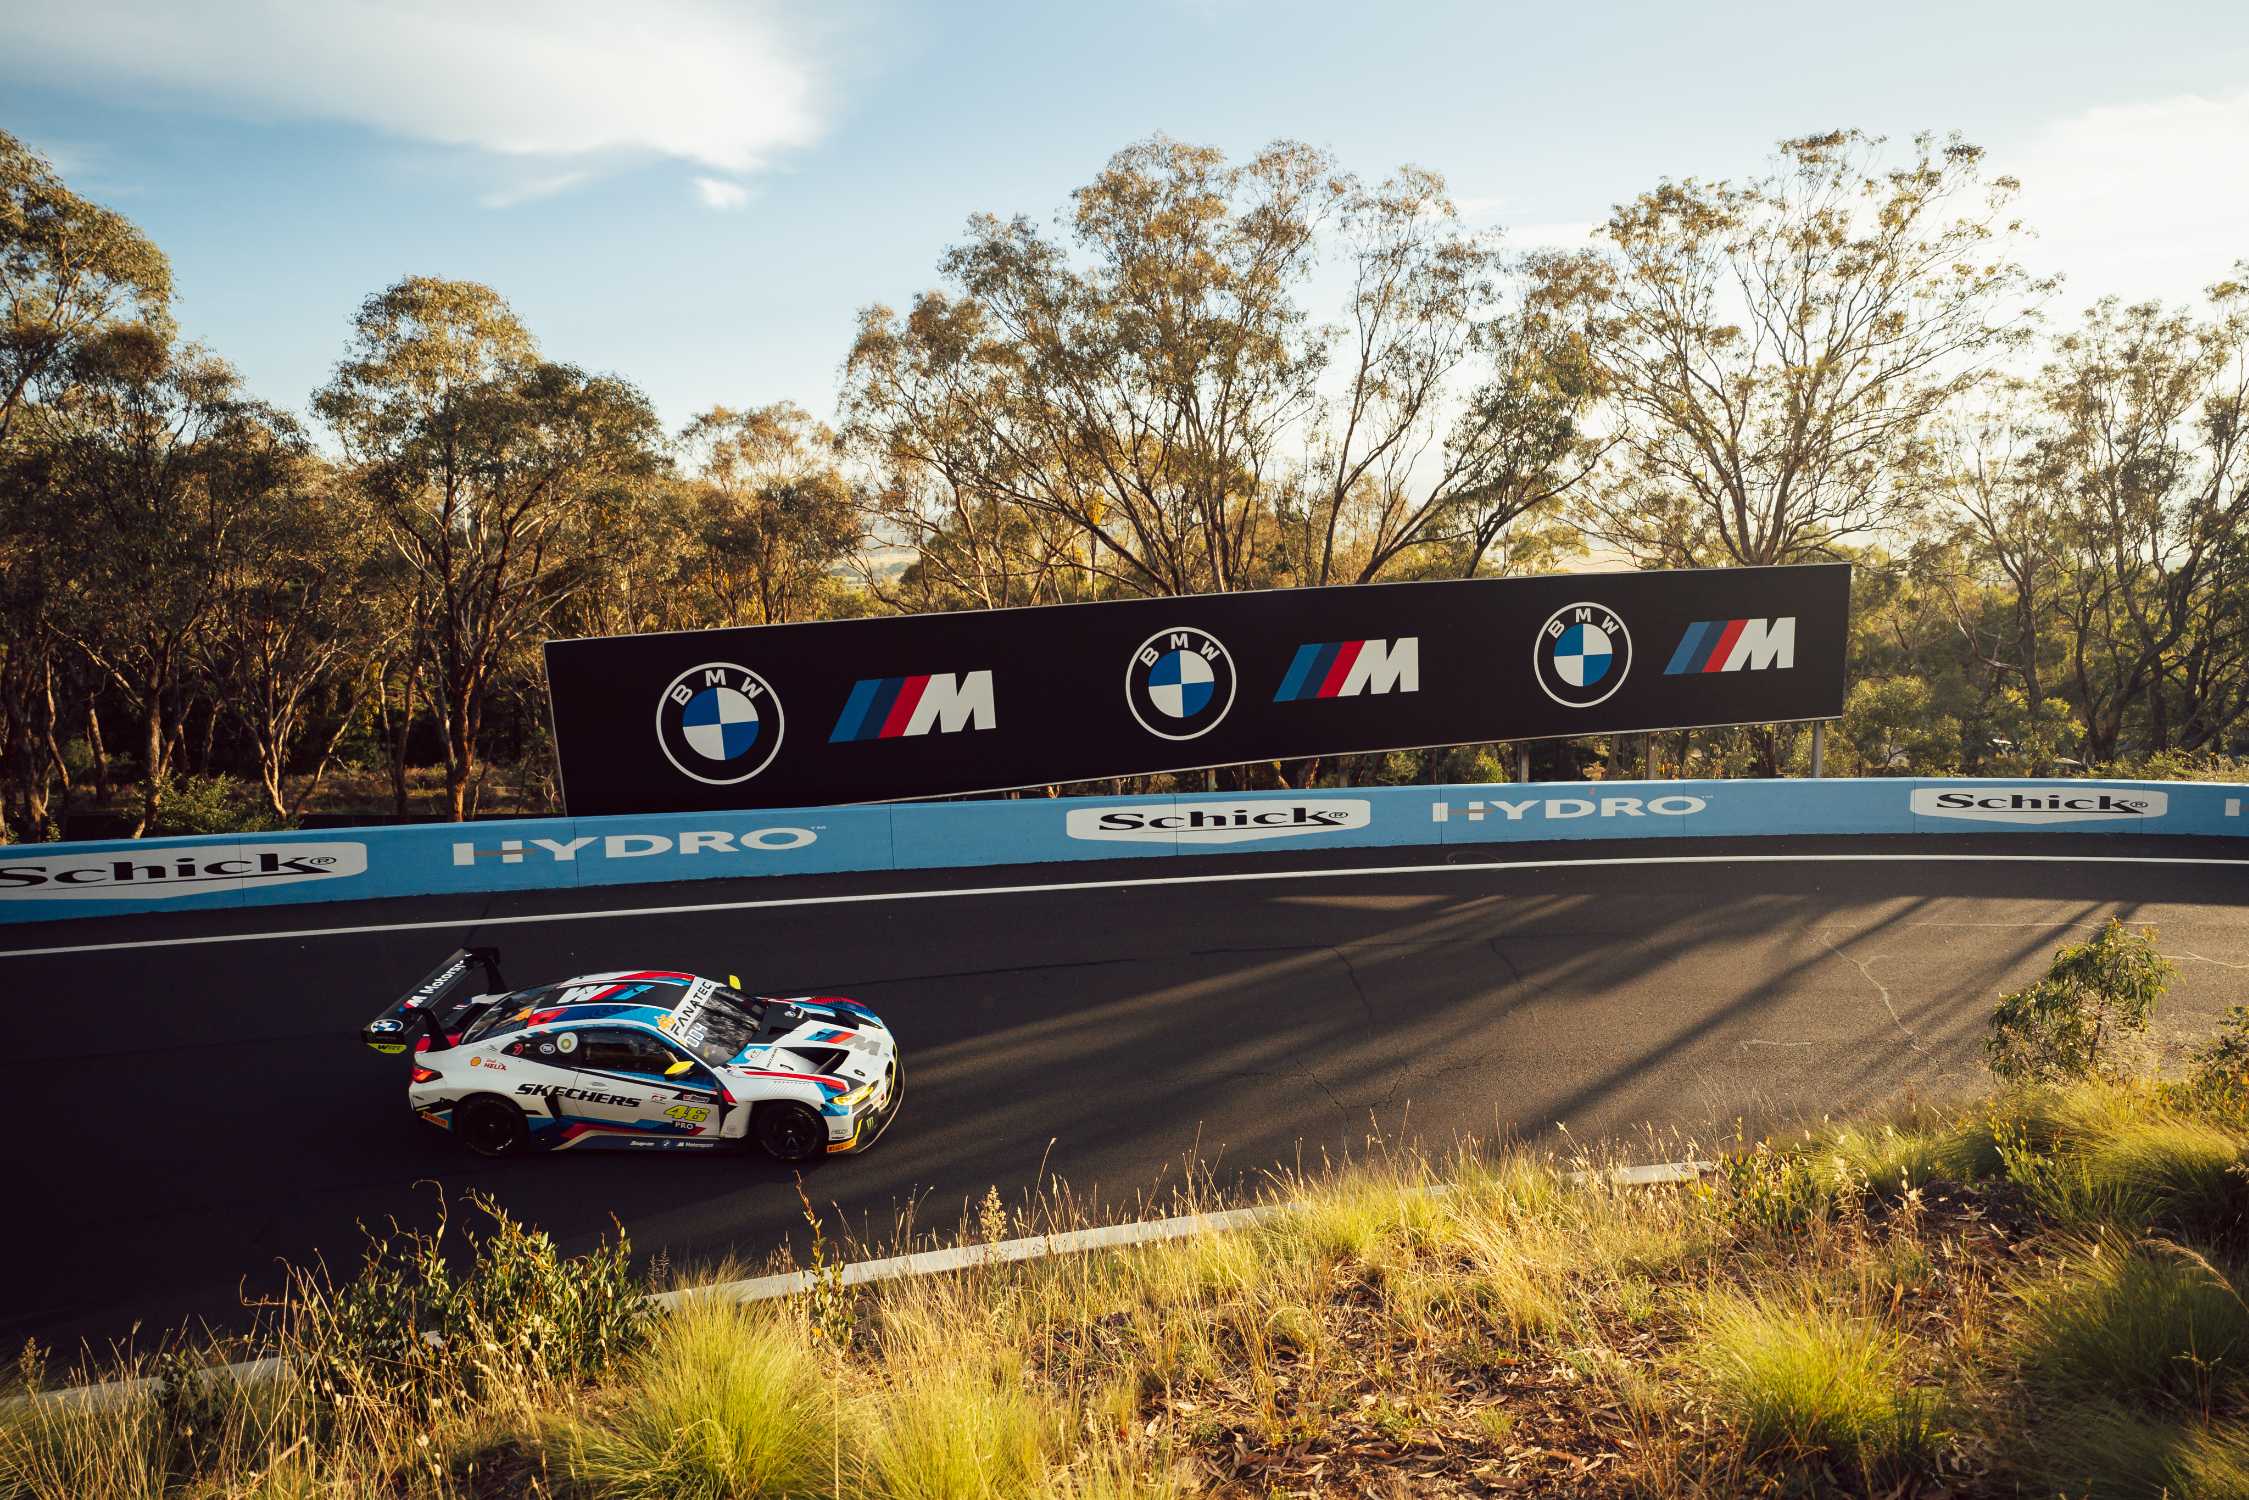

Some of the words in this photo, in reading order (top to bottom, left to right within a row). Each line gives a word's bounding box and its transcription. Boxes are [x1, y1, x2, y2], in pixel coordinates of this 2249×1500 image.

[1547, 607, 1620, 640] BMW
[1138, 631, 1222, 668] BMW
[670, 668, 765, 707] BMW
[670, 981, 713, 1037] FANATEC
[514, 1083, 642, 1108] SKECHERS
[663, 1104, 711, 1123] 46
[674, 1121, 695, 1130] PRO
